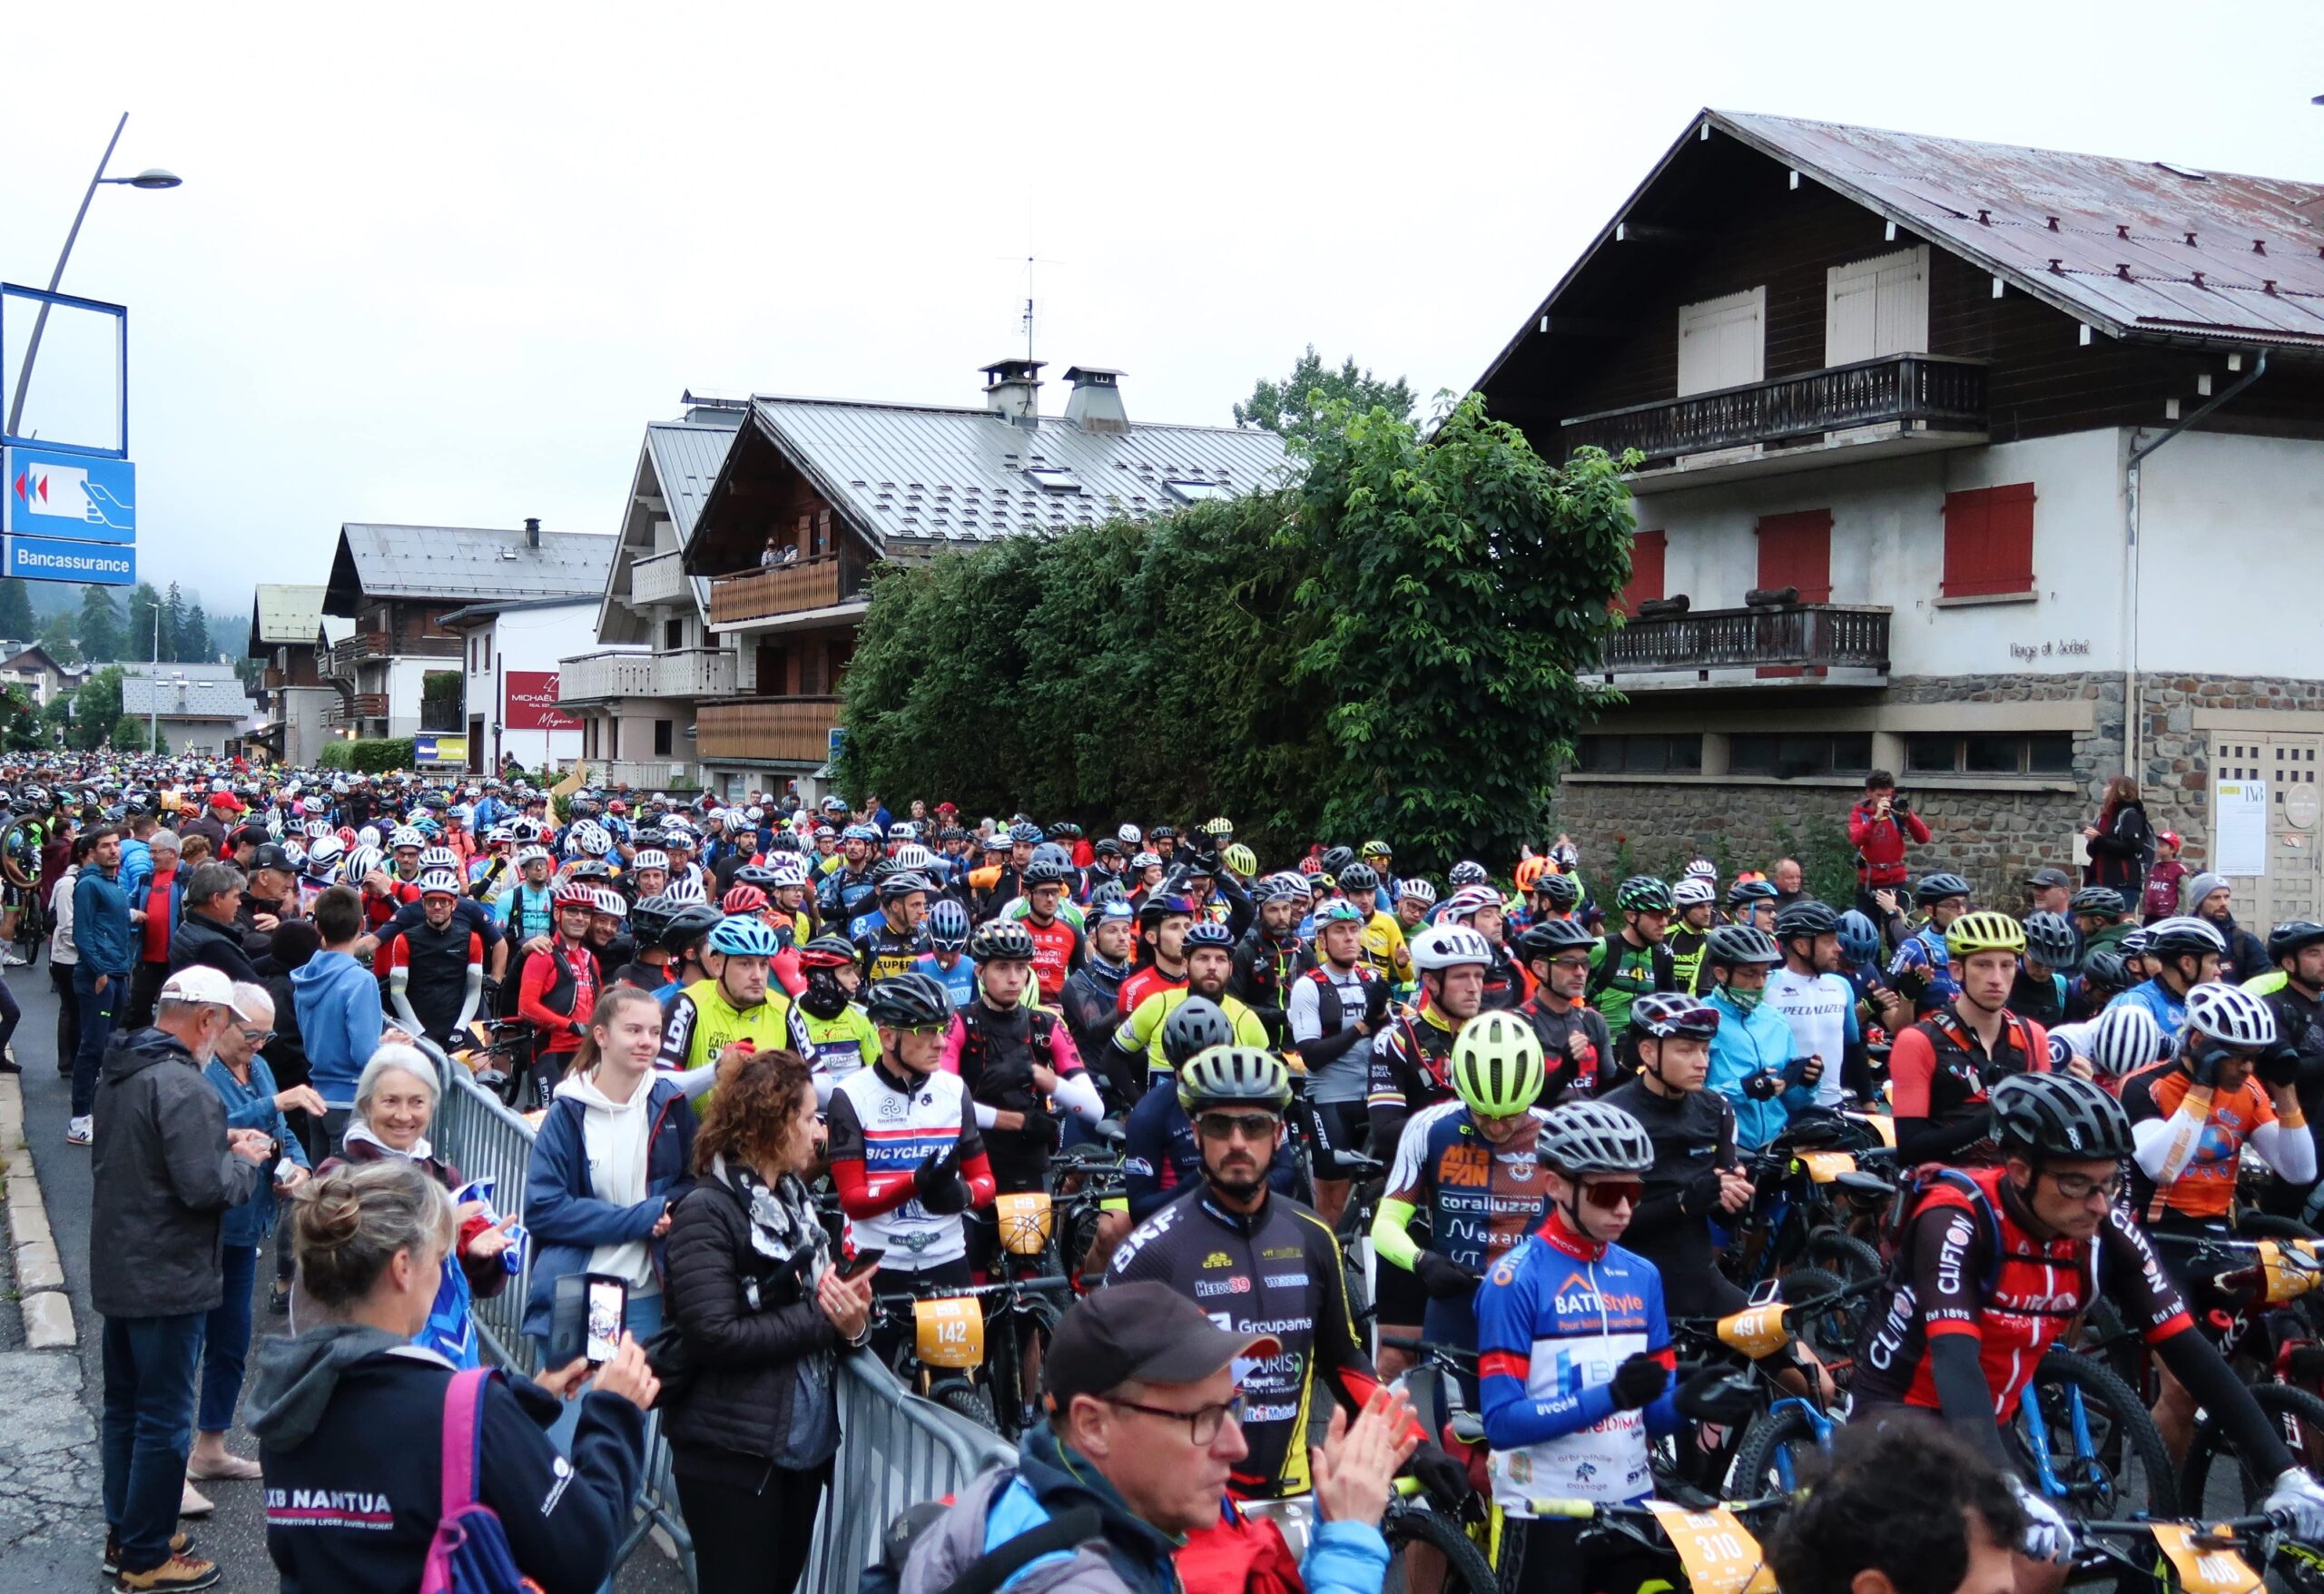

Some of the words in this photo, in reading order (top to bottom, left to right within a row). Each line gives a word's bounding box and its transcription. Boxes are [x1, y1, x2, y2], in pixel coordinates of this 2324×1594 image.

[18, 548, 130, 573] Bancassurance
[1777, 1004, 1846, 1015] PECIALIZED
[662, 998, 694, 1054] LDM
[788, 1006, 816, 1060] LDM
[1438, 1162, 1489, 1187] FAN
[1441, 1196, 1541, 1213] coralluzzo
[1112, 1205, 1177, 1274] SKF
[2111, 1208, 2168, 1294] CLIFTON
[1937, 1214, 1974, 1295] CLIFTON
[1264, 1274, 1309, 1287] mazars
[1603, 1293, 1643, 1315] Style
[1925, 1311, 1939, 1322] Est
[1942, 1308, 1970, 1321] 1895
[936, 1321, 967, 1343] 142
[1238, 1317, 1313, 1334] Groupama
[292, 1489, 391, 1513] NANTUA
[1695, 1531, 1743, 1562] 310
